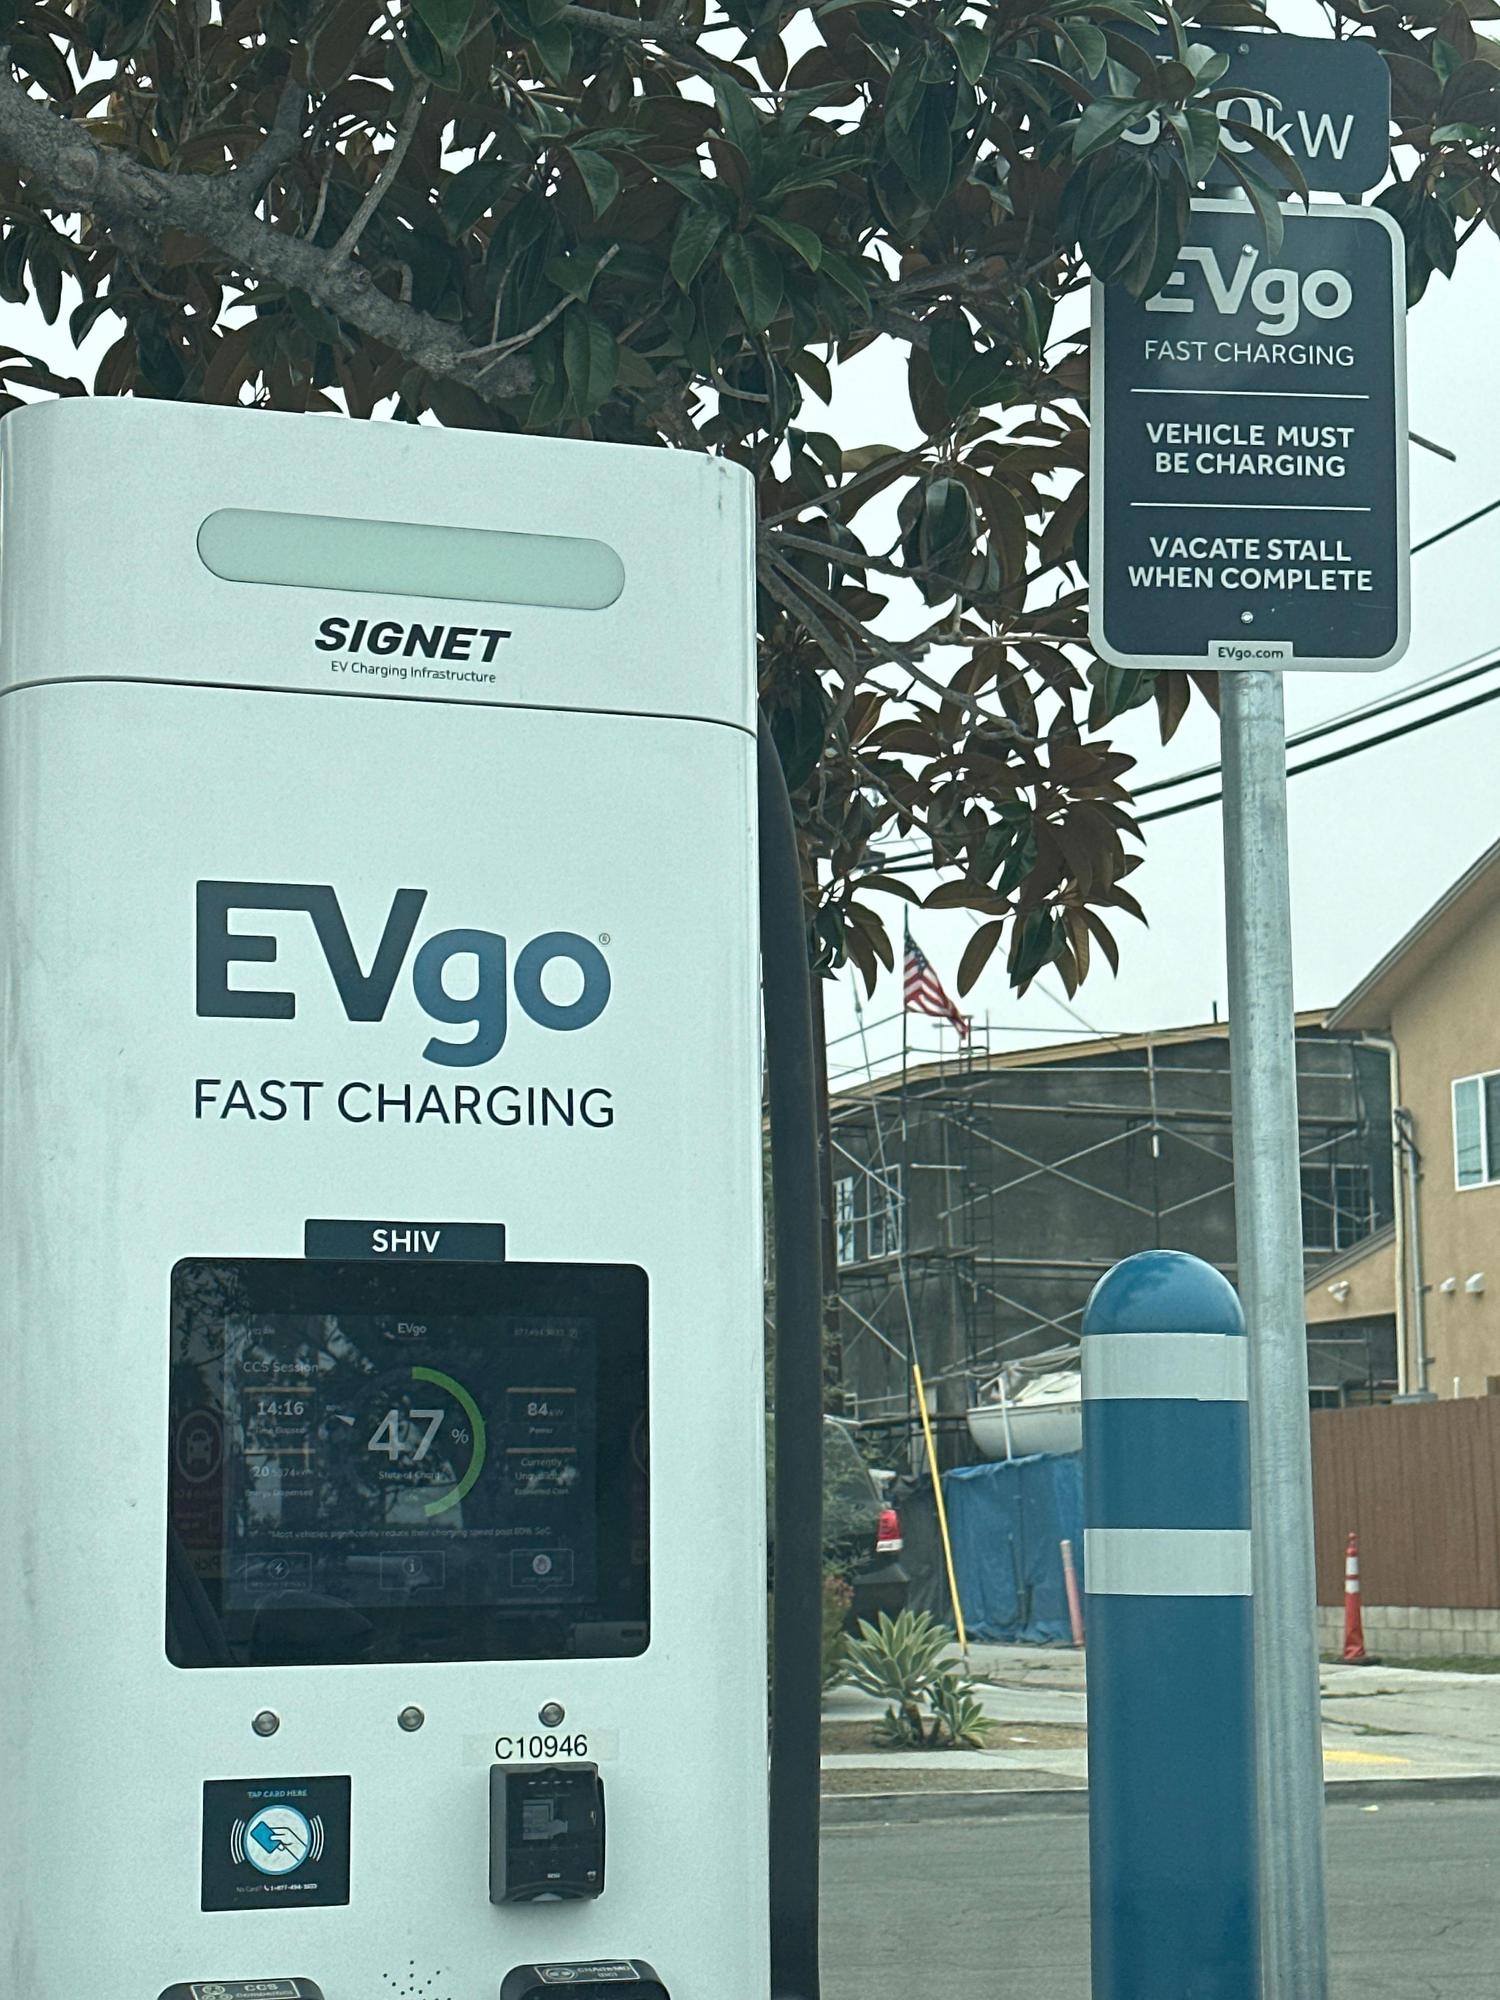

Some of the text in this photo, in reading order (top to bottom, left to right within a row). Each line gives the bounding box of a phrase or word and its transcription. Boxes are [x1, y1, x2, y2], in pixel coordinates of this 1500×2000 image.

[1145, 246, 1353, 337] EVgo
[1145, 339, 1354, 366] FAST CHARGING
[1146, 422, 1355, 449] VEHICLE MUST
[1155, 452, 1346, 477] BE CHARGING
[1149, 537, 1352, 562] VACATE STALL
[1128, 566, 1373, 591] WHEN COMPLETE
[315, 617, 512, 663] SIGNET
[1218, 646, 1284, 661] EVgo.com
[331, 660, 496, 683] EV Charging Infrastructure
[196, 1078, 615, 1128] FAST CHARGING
[372, 1229, 441, 1254] SHIV
[397, 1322, 427, 1337] EVgo
[243, 1361, 319, 1373] CCS Session
[257, 1401, 304, 1416] 14:16
[368, 1408, 469, 1461] 47 %
[521, 1457, 562, 1468] Currently
[495, 1734, 588, 1760] C10946
[247, 1788, 309, 1799] TAP CARD HERE
[244, 1983, 278, 1992] CCS
